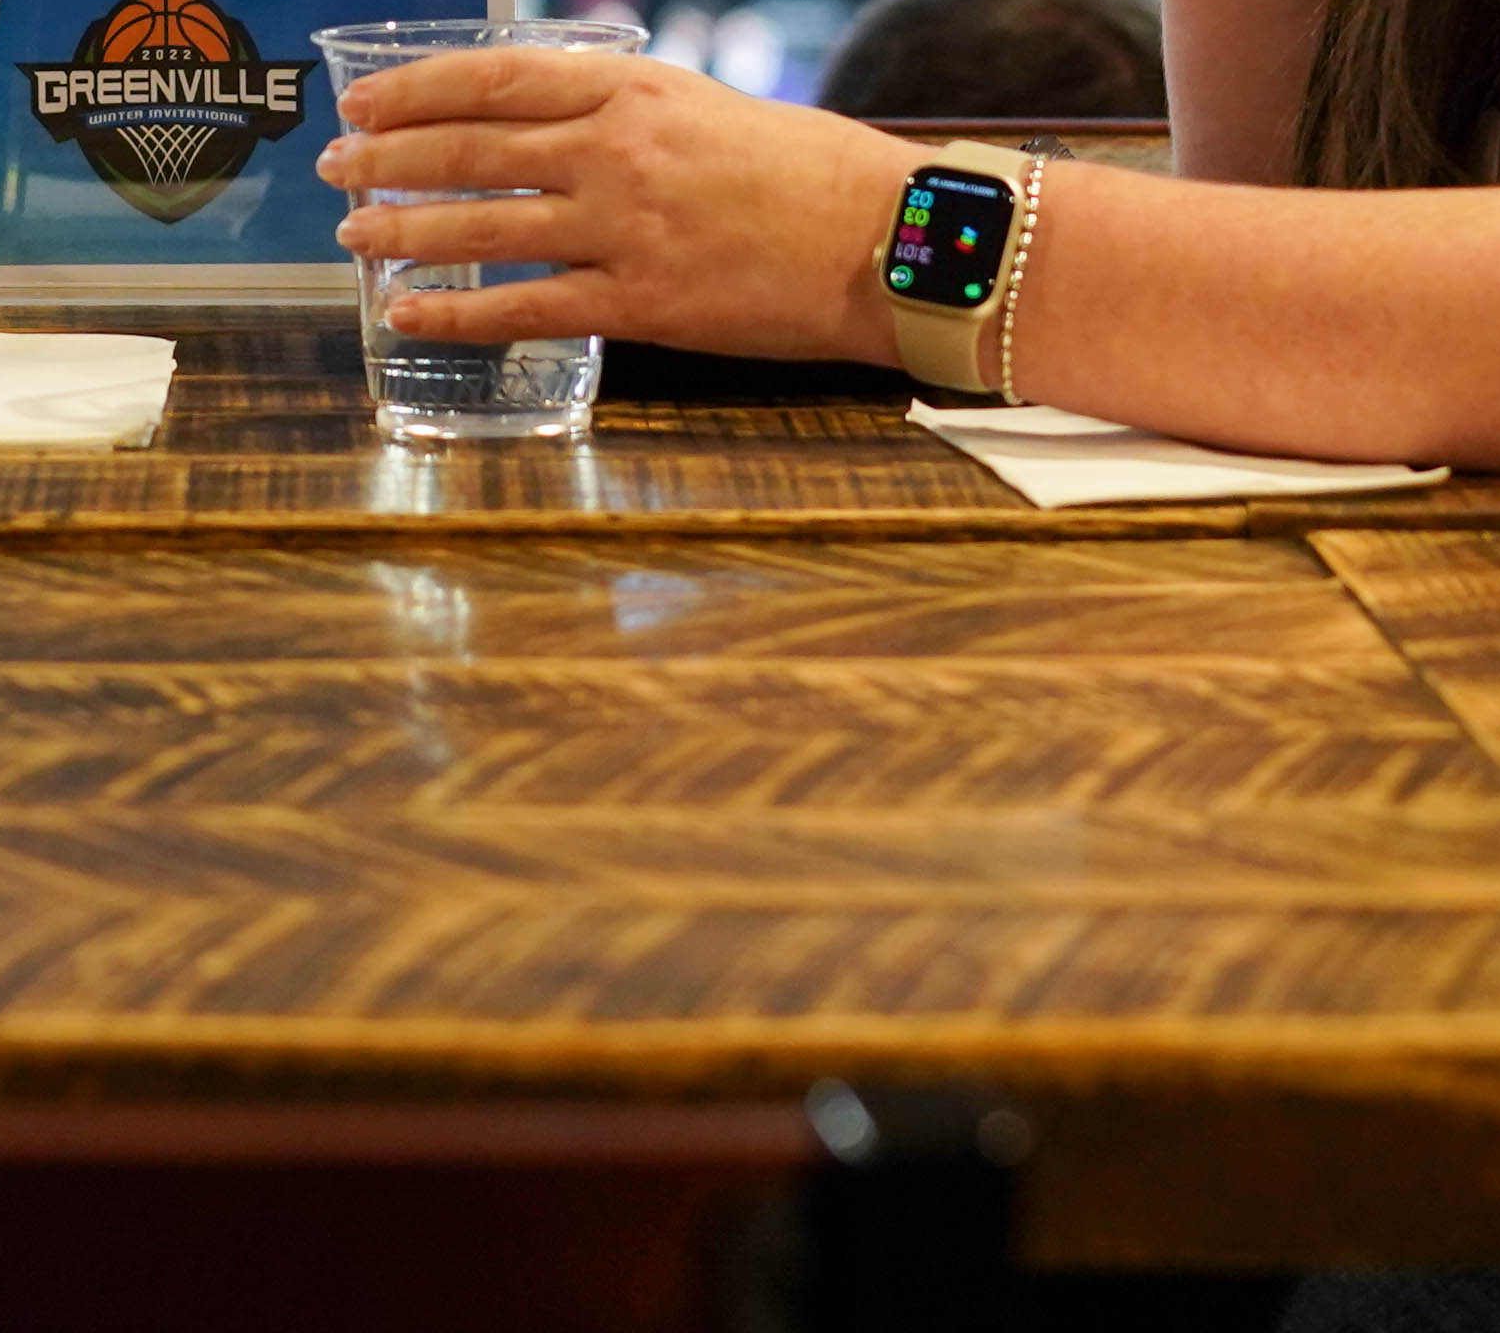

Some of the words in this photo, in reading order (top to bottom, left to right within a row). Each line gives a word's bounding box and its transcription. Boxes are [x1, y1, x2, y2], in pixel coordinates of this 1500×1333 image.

[141, 48, 192, 61] 2022
[34, 68, 301, 114] GREENVILLE
[88, 110, 144, 125] WINTER
[149, 107, 246, 125] INVITATIONAL
[908, 189, 935, 208] 02
[904, 208, 931, 227] 03
